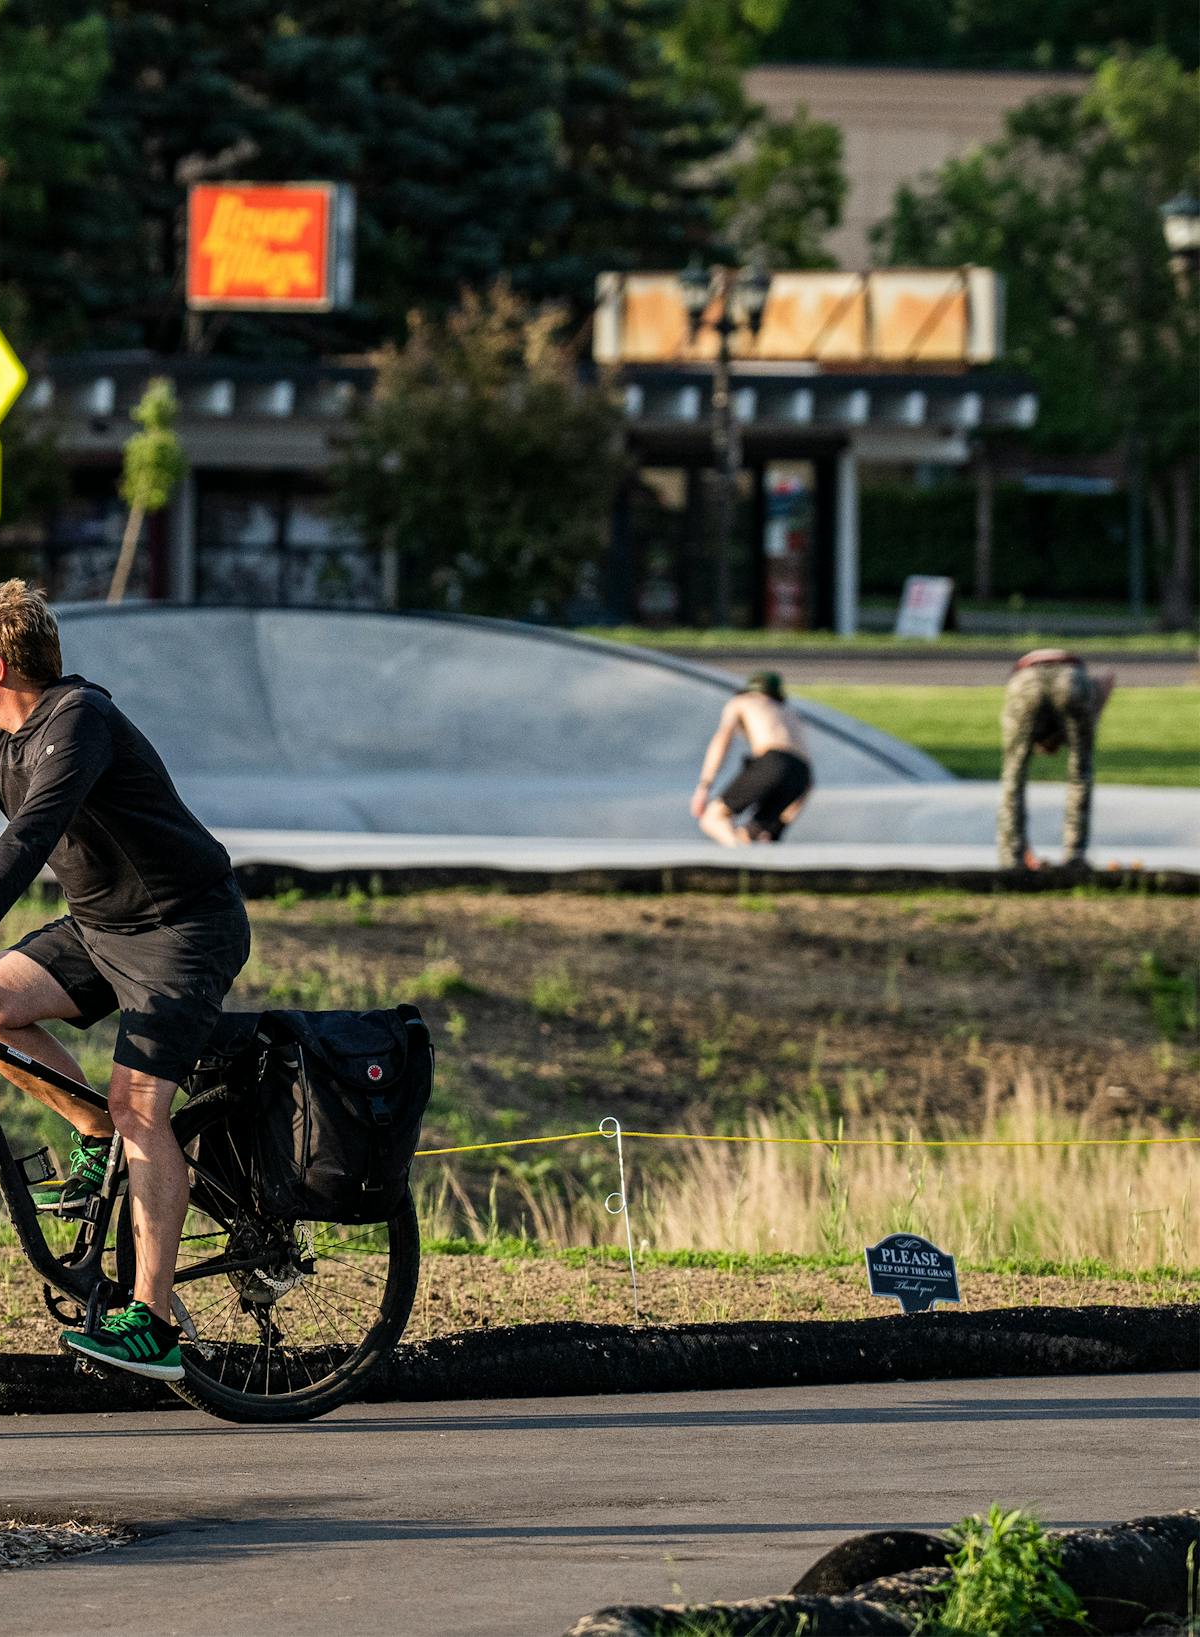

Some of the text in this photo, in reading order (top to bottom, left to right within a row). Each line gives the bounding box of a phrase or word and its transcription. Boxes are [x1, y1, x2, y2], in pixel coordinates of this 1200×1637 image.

[881, 1248, 940, 1266] PLEASE
[873, 1264, 952, 1278] KEEP OFF THE GRASS
[893, 1280, 921, 1291] Thank
